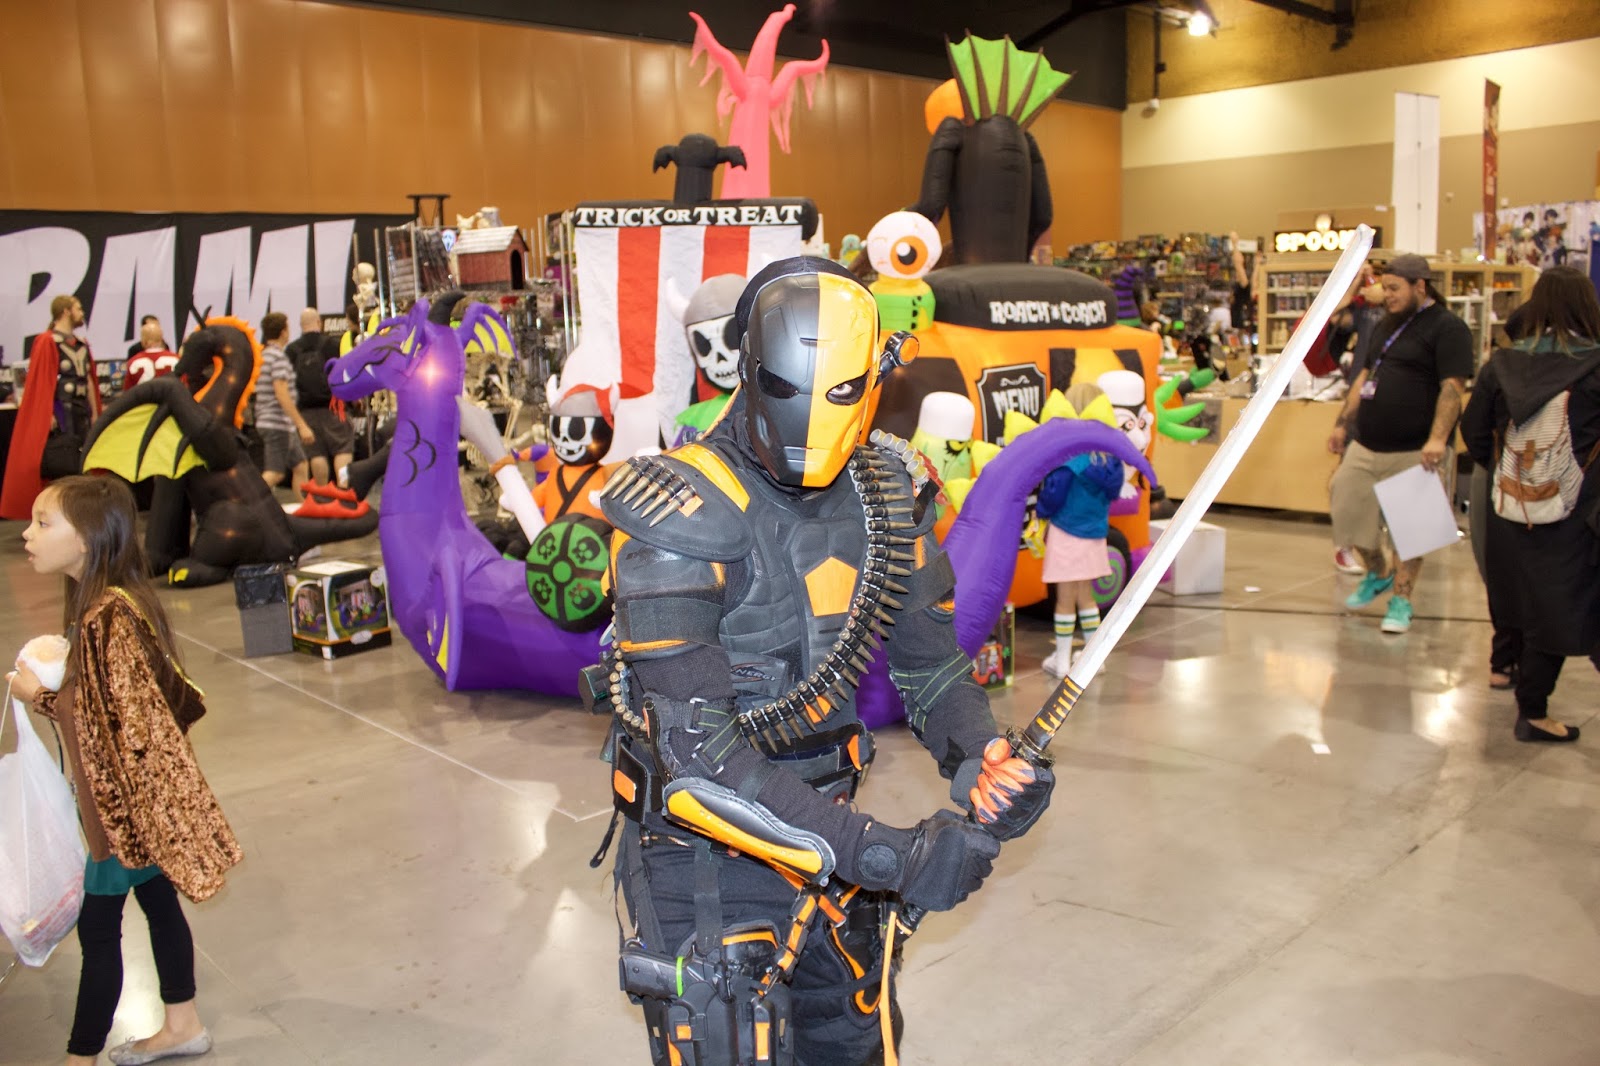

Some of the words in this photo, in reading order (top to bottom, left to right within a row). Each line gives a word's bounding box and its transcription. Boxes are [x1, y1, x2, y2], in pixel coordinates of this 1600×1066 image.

[576, 207, 665, 226] TRICK
[664, 208, 693, 223] OR
[693, 205, 802, 225] TREAT
[989, 300, 1051, 324] ROACH
[1060, 300, 1107, 326] COACH
[992, 386, 1040, 420] MENU
